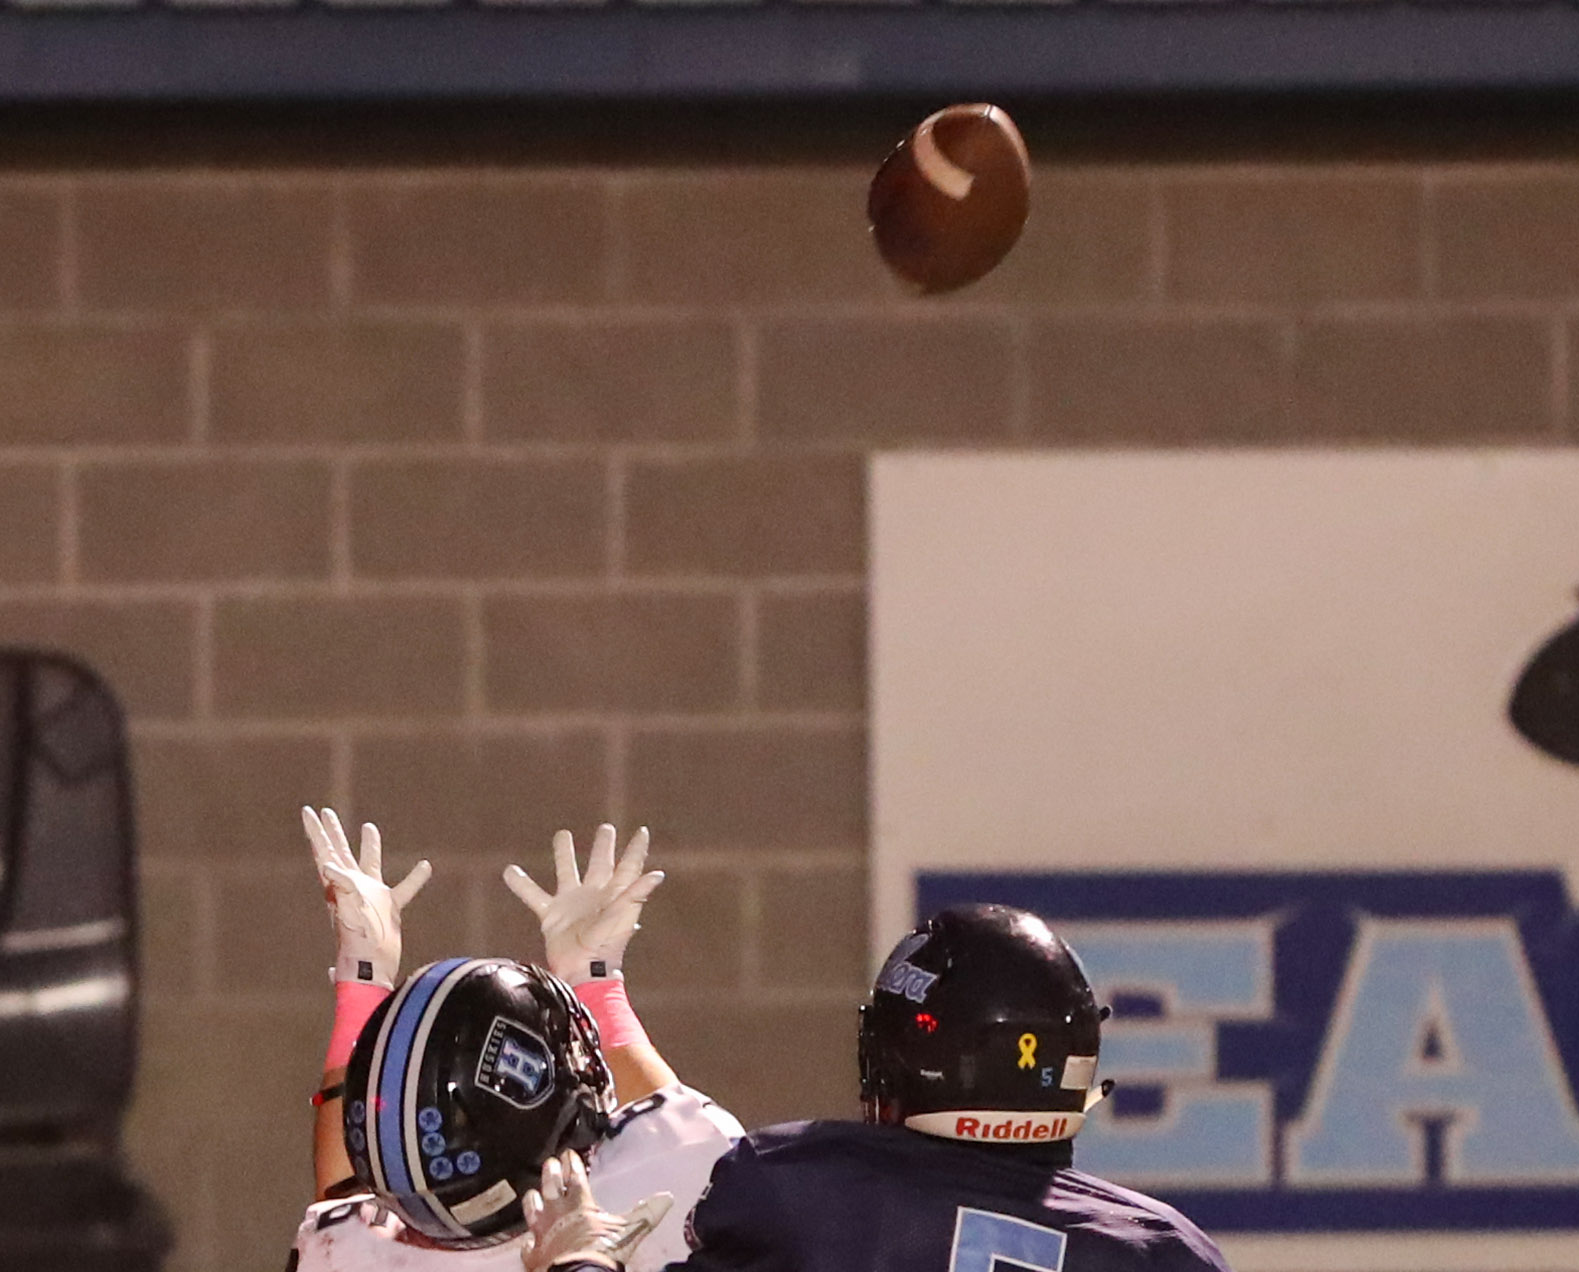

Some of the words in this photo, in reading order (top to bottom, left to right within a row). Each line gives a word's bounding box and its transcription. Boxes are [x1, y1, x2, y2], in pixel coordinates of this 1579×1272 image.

[479, 1022, 507, 1085] HUSKIES
[1040, 1066, 1054, 1087] 5
[954, 1116, 1068, 1140] Riddell
